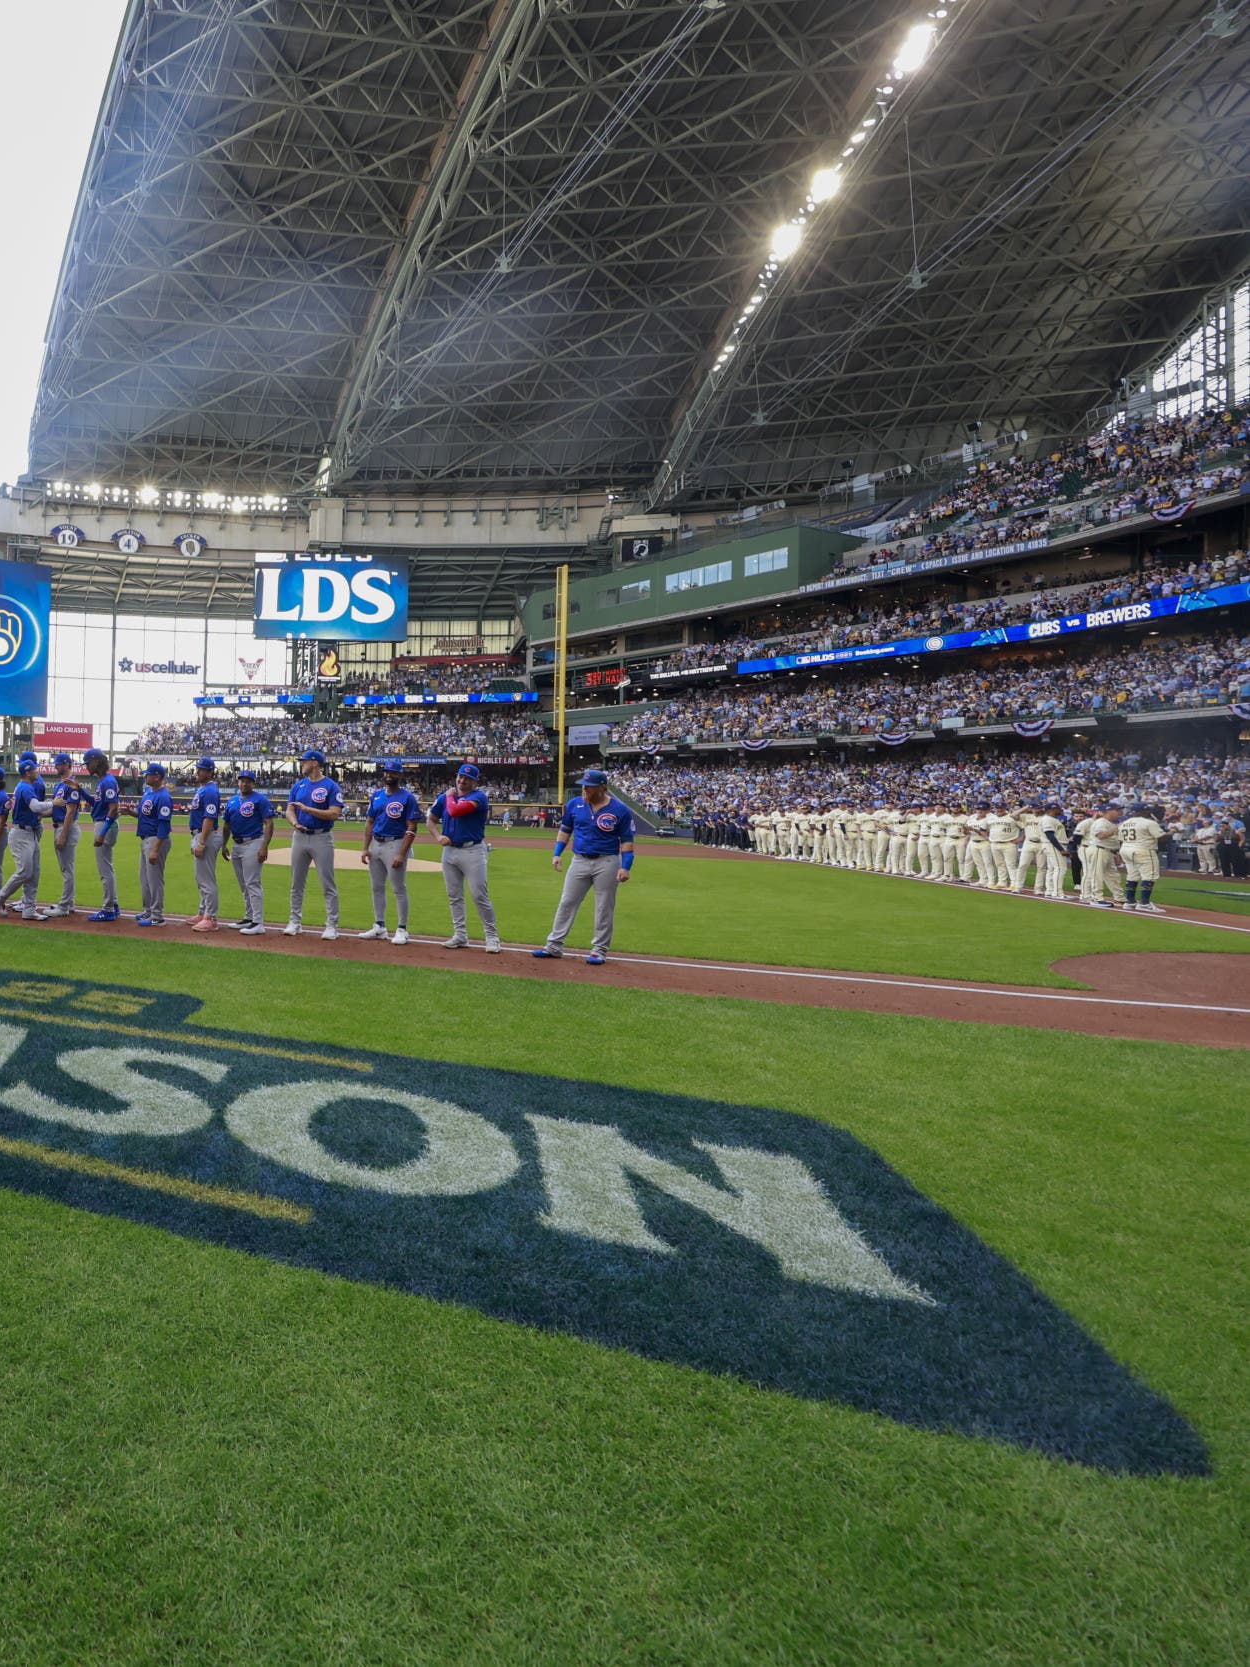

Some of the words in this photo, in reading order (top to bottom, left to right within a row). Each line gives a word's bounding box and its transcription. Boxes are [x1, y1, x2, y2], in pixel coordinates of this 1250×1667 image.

[60, 533, 76, 545] 19
[123, 538, 132, 550] 4
[871, 570, 885, 580] TEXT
[952, 555, 969, 565] ISSUE
[971, 551, 984, 561] AND
[985, 545, 1015, 559] LOCATION
[1016, 543, 1025, 552] TO
[254, 568, 396, 624] LDS
[1028, 619, 1061, 638] CUBS
[1066, 618, 1081, 628] vs
[1086, 603, 1152, 628] BREWERS
[433, 635, 484, 648] Johnsonville
[811, 653, 835, 663] NLDS
[855, 647, 895, 656] Booking.com
[134, 660, 201, 675] uscellular
[1121, 829, 1136, 841] 23
